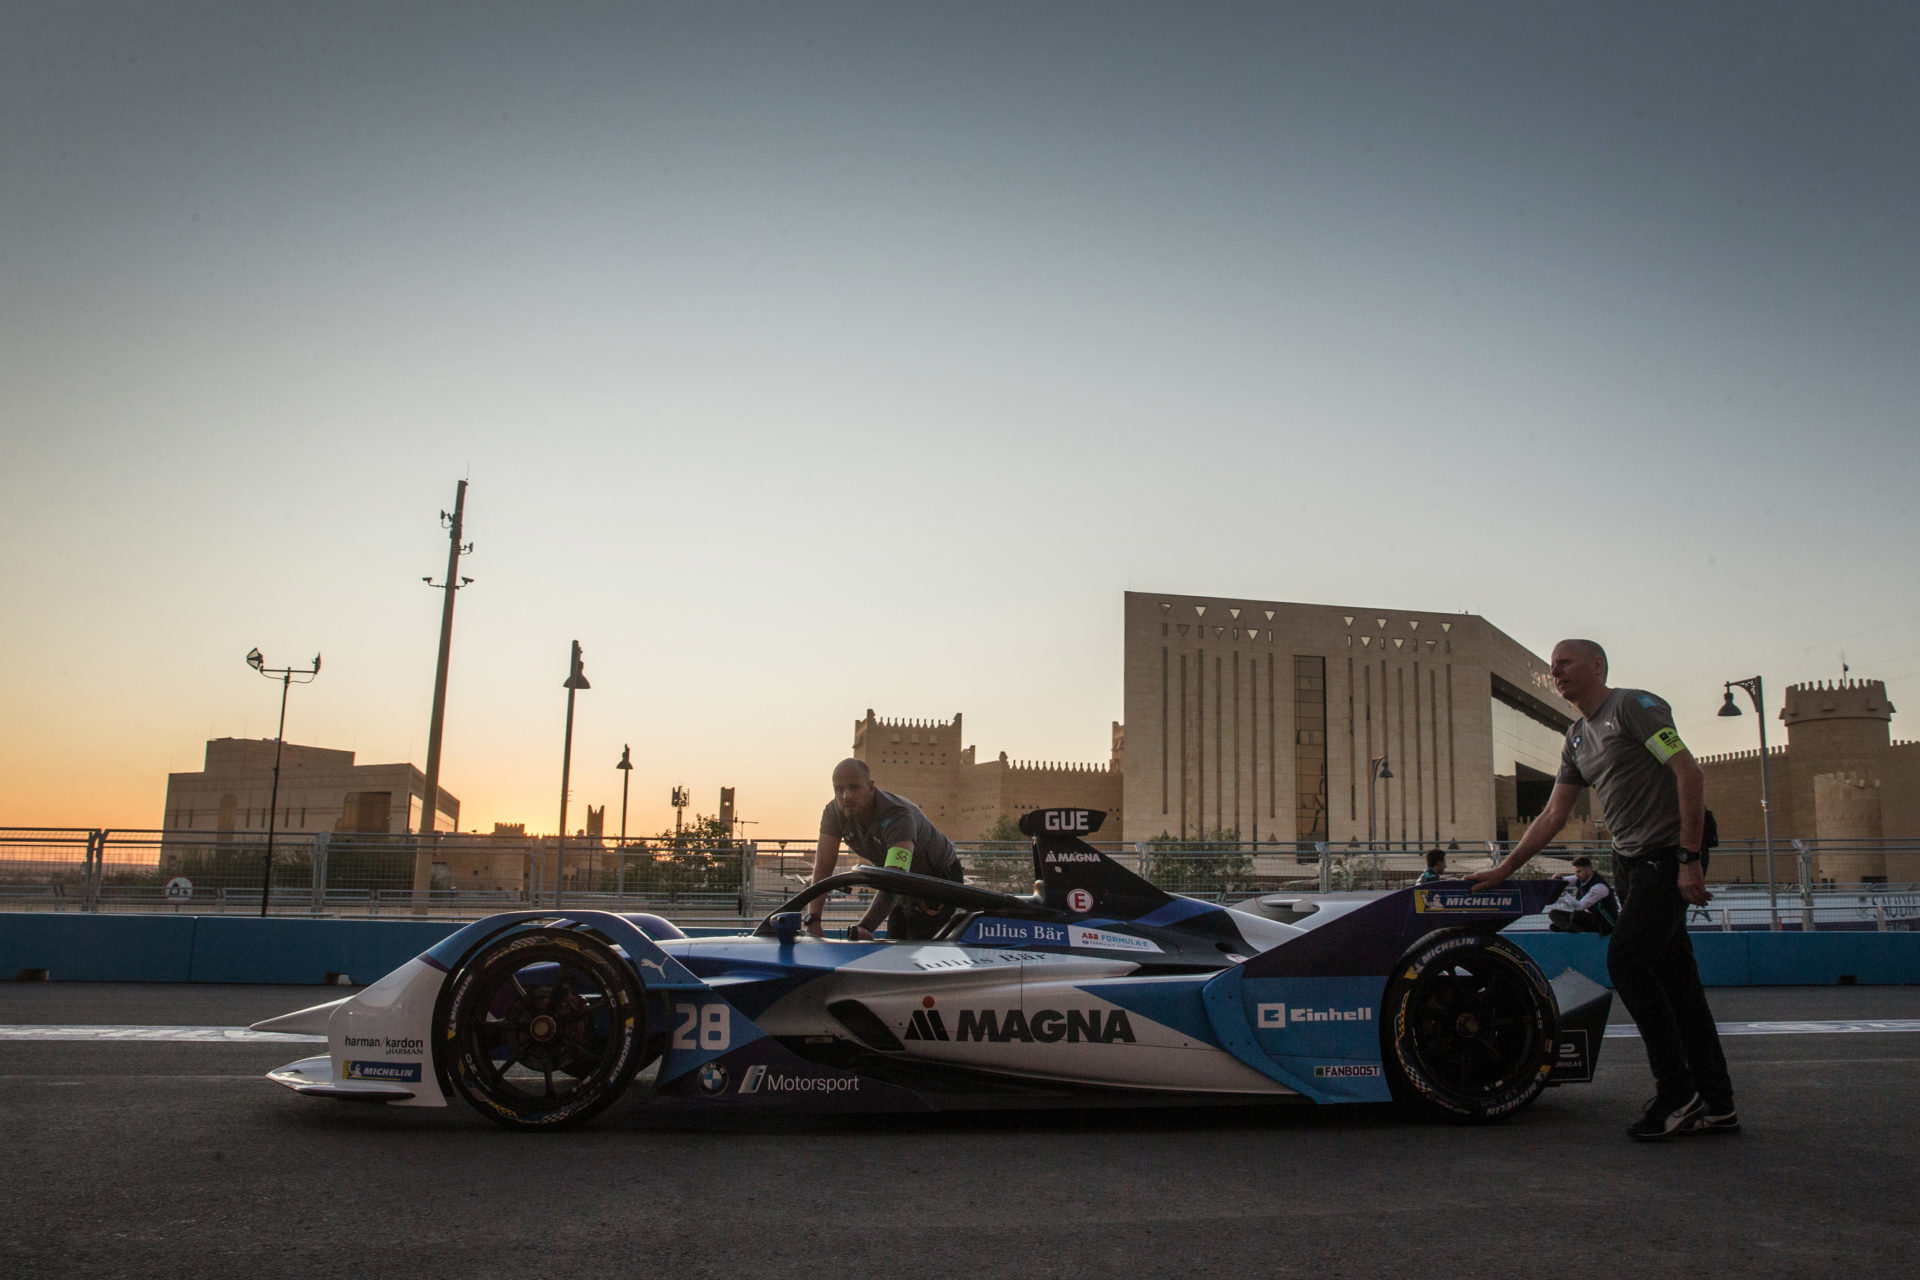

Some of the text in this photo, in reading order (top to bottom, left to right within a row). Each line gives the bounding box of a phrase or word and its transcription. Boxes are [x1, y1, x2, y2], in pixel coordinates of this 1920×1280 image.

[1045, 811, 1089, 830] GUE
[1058, 852, 1101, 862] MAGNA
[1074, 893, 1086, 909] E
[1446, 897, 1512, 906] MICHELIN
[978, 923, 1064, 941] Julius Bär
[1081, 932, 1099, 940] ABB
[1421, 938, 1475, 963] MICHELIN
[914, 953, 1046, 971] Julius Bär
[449, 974, 472, 1020] MICHELIN
[1290, 1007, 1371, 1021] Einhell
[672, 1003, 730, 1050] 28
[956, 1009, 1137, 1043] MAGNA
[345, 1036, 423, 1048] harman/kardon
[608, 1035, 631, 1083] MICHELIN
[363, 1067, 414, 1077] MICHELIN
[768, 1074, 859, 1093] Motorsport
